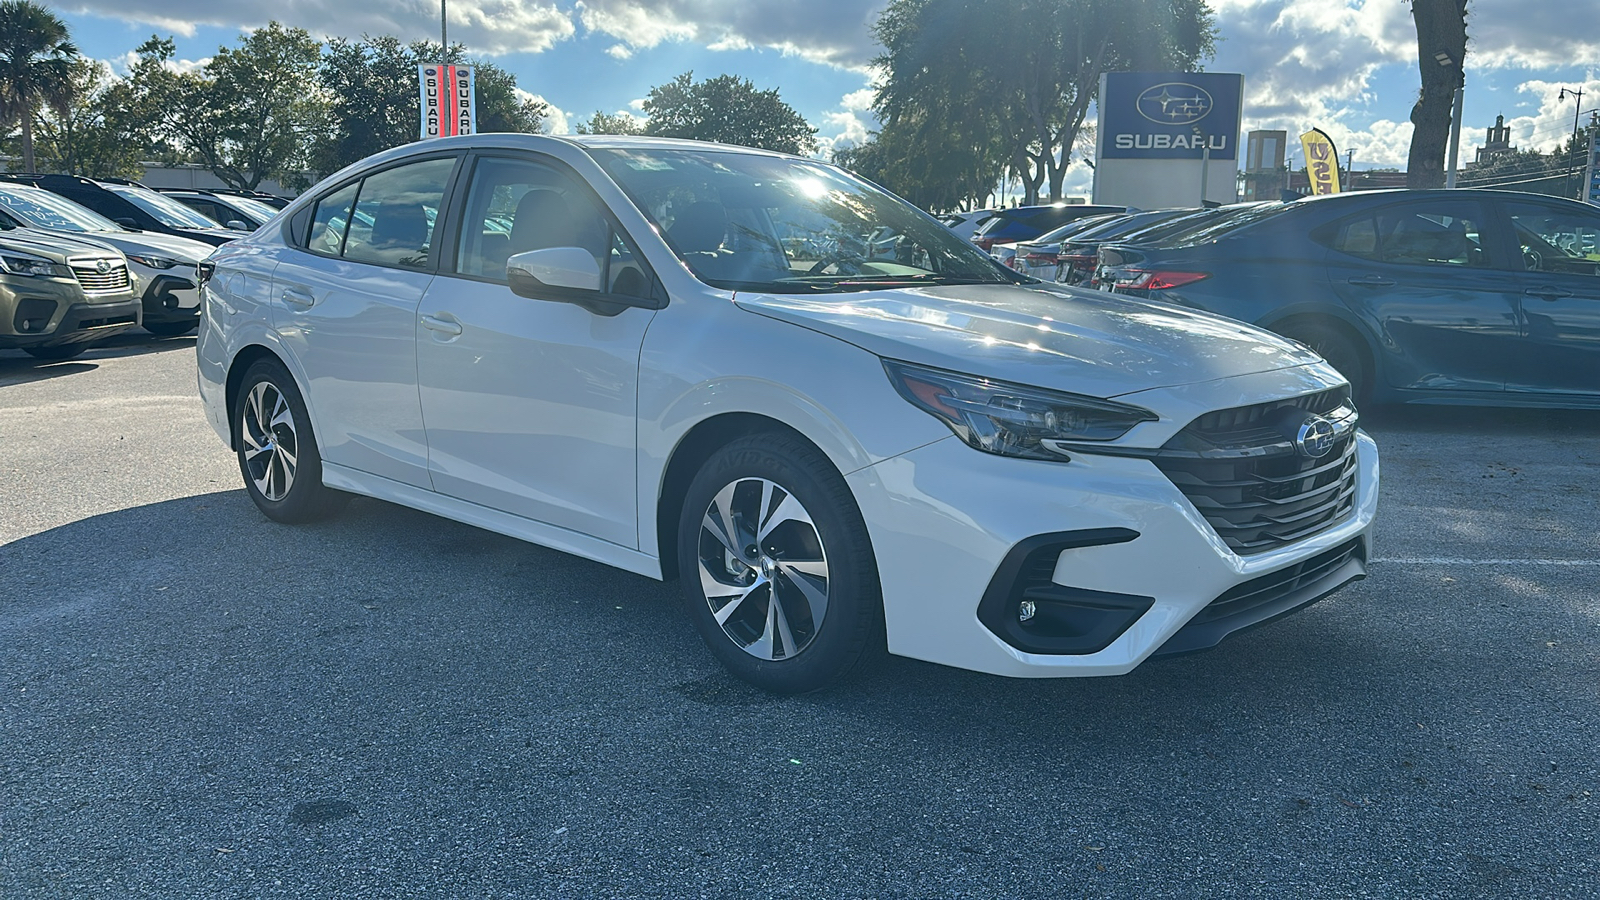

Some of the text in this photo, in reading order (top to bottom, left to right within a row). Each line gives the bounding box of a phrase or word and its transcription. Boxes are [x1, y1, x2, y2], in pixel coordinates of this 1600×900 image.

[427, 78, 438, 135] SUBARU
[458, 80, 470, 135] SUBARU
[1115, 133, 1227, 150] SUBARU
